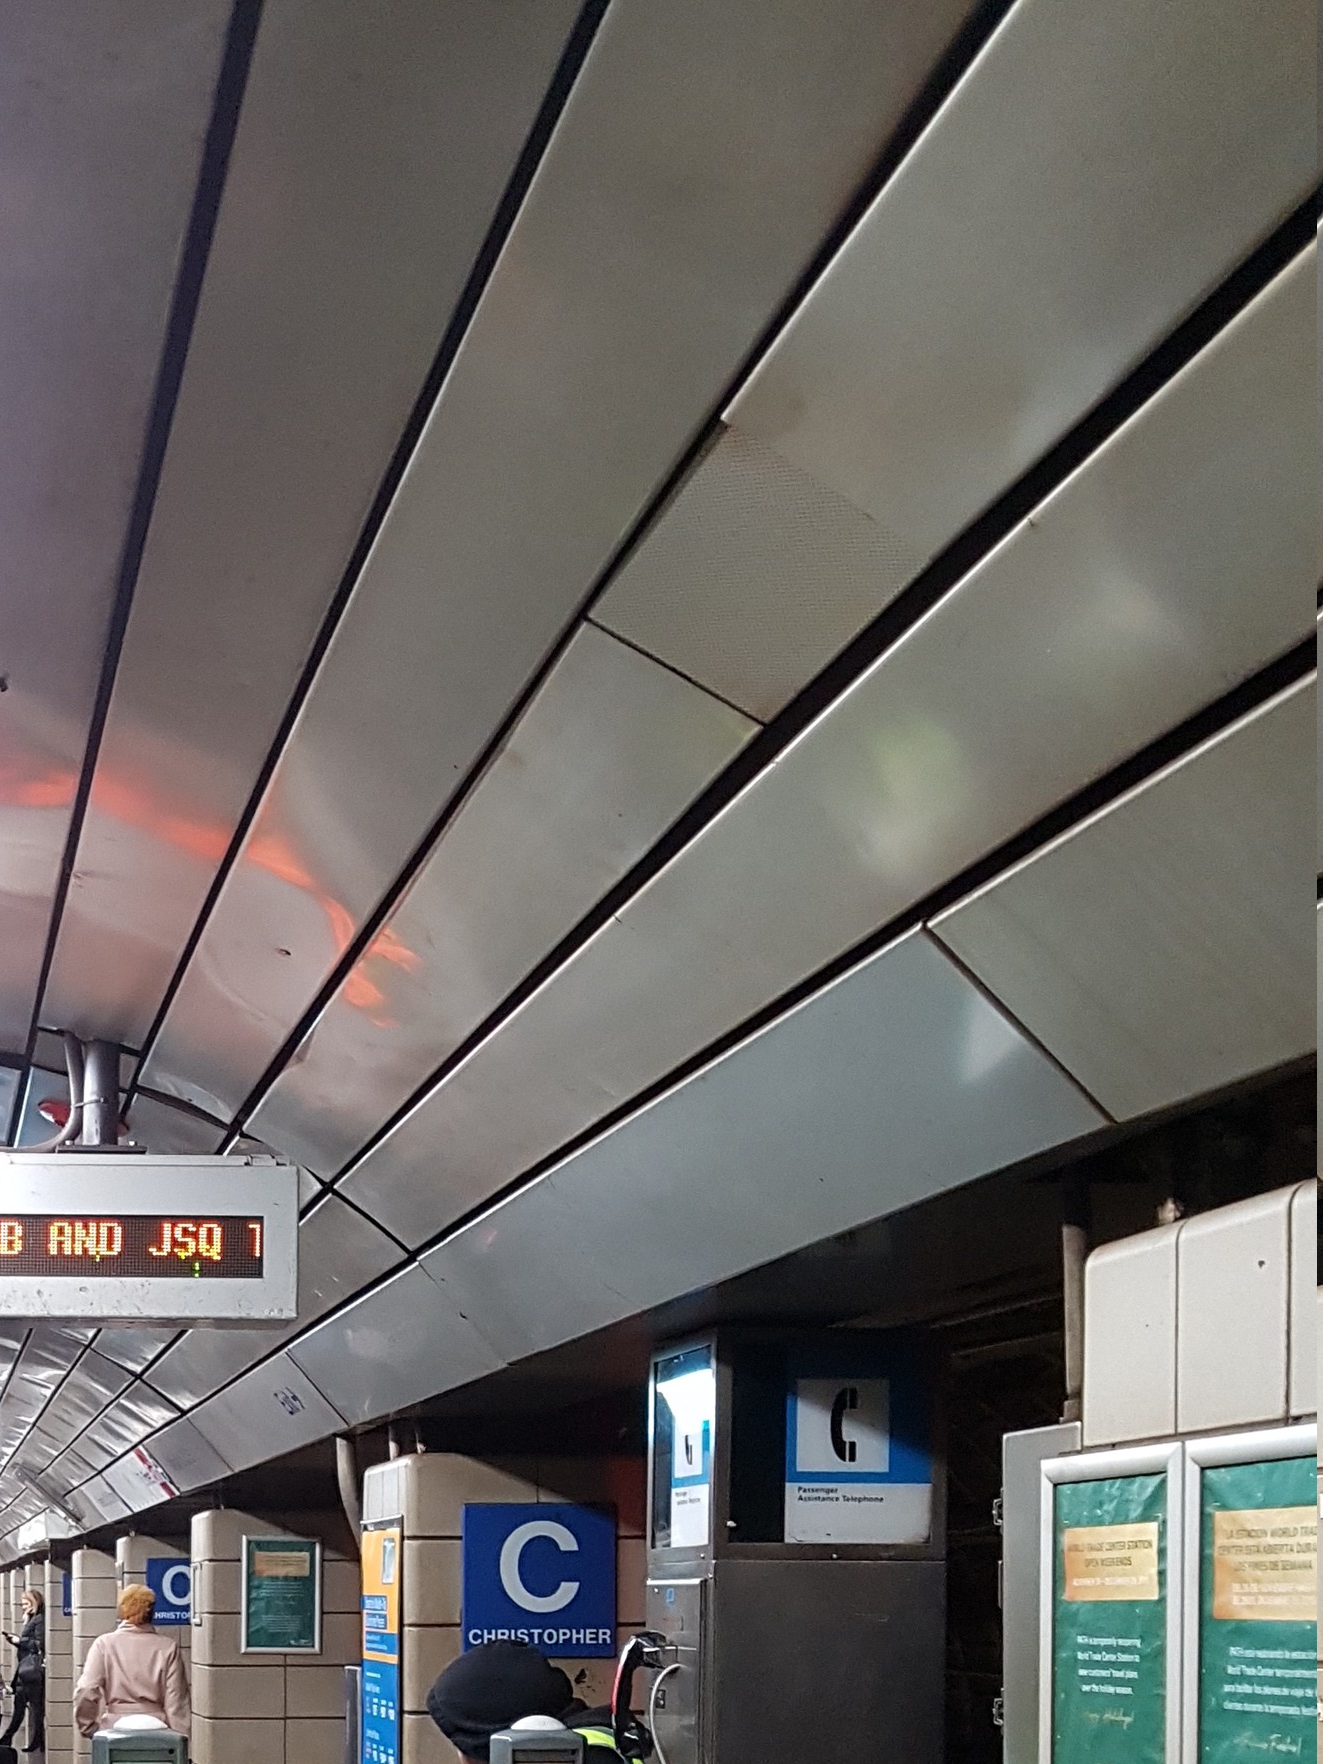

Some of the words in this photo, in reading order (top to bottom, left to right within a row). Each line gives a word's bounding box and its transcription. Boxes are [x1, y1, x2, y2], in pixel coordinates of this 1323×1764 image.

[48, 1220, 123, 1257] AND
[148, 1221, 222, 1260] JSQ
[797, 1486, 838, 1495] Passenger
[842, 1495, 884, 1503] Telephone
[499, 1520, 580, 1613] C
[468, 1628, 612, 1645] CHRISTOPHER
